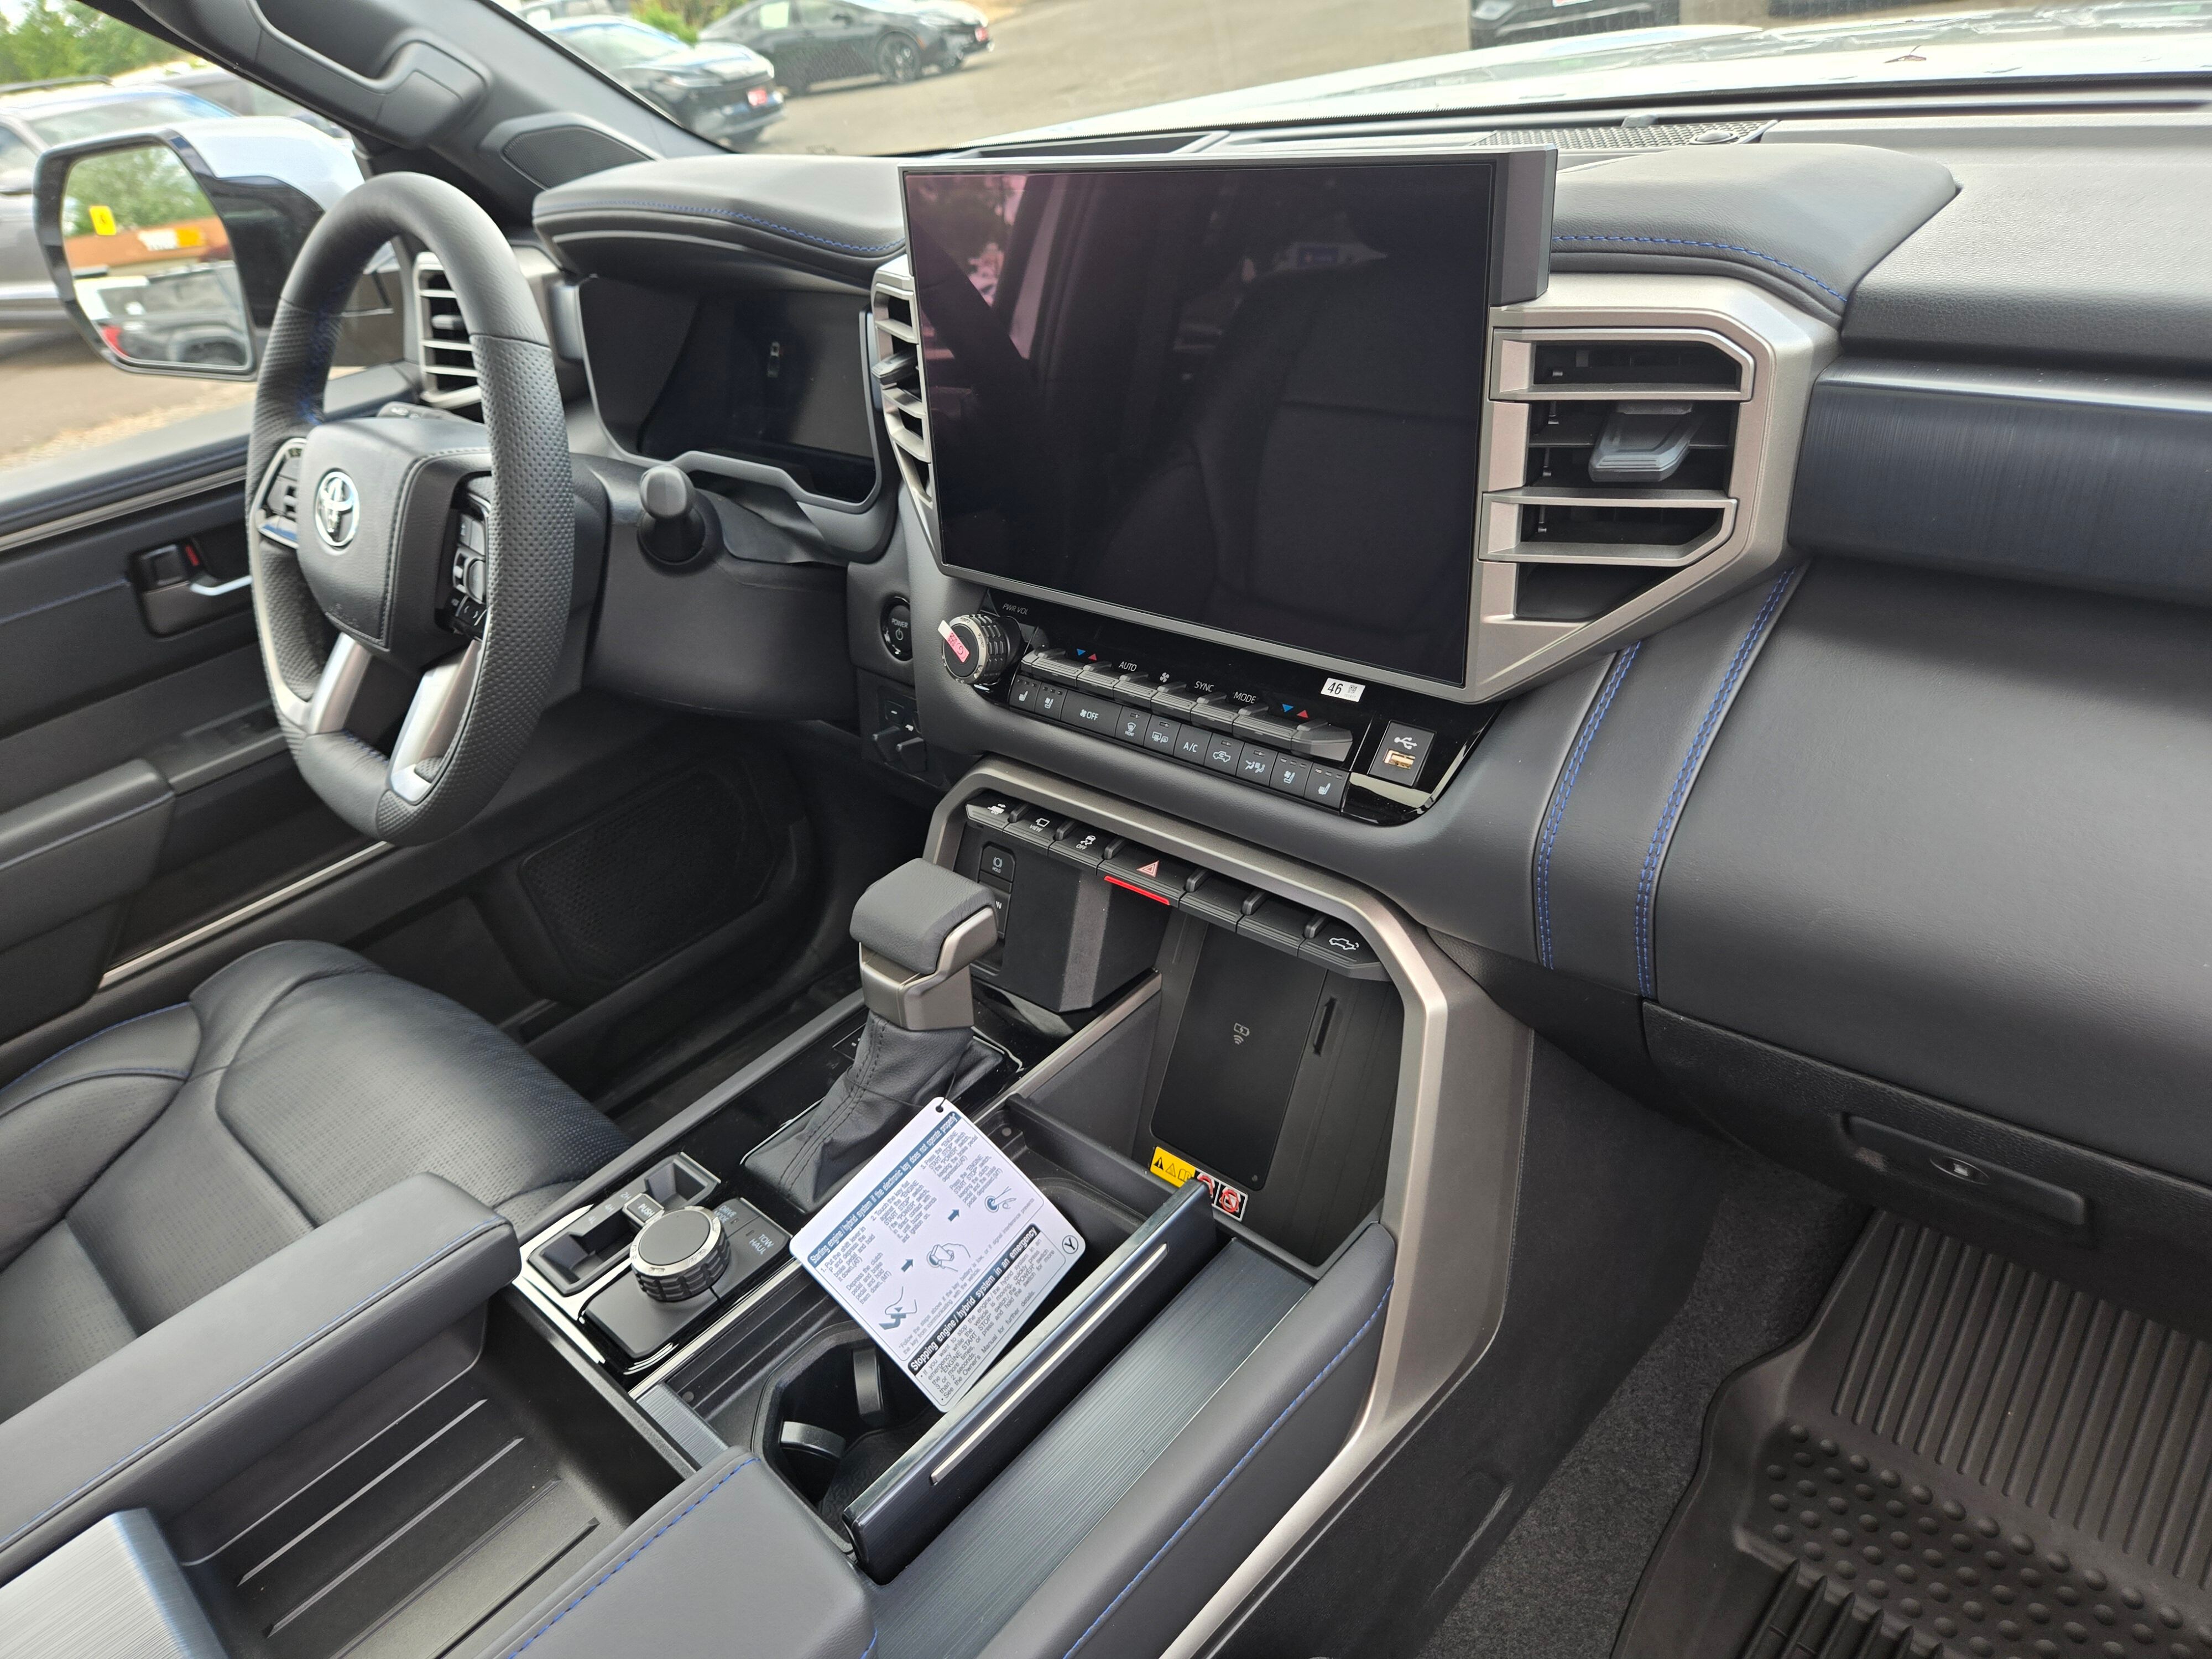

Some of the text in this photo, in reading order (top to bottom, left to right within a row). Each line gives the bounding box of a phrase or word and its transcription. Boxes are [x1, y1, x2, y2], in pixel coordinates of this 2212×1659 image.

[1003, 603, 1030, 615] PWR VOL
[891, 618, 908, 628] POWER
[1118, 661, 1137, 672] AUTO
[1194, 681, 1214, 692] SYNC
[1328, 682, 1343, 695] 46
[1233, 691, 1257, 704] MODE
[1086, 711, 1099, 721] OFF
[1183, 742, 1198, 753] A/C
[1029, 824, 1043, 832] VIEW
[620, 1191, 632, 1201] 2H
[605, 1203, 615, 1213] 4H
[638, 1203, 655, 1217] PUSH
[719, 1205, 737, 1217] DRIVE
[873, 1201, 889, 1217] Touch
[714, 1211, 729, 1223] MODE
[749, 1238, 766, 1255] HAUL
[759, 1234, 774, 1248] TOW
[823, 1258, 834, 1269] Put
[831, 1250, 842, 1260] the
[839, 1240, 851, 1253] shift
[849, 1230, 862, 1243] lever
[858, 1224, 867, 1233] in
[845, 1271, 865, 1291] Depress
[909, 1339, 940, 1373] Stopping
[973, 1273, 997, 1300] system
[993, 1265, 1003, 1276] in
[1000, 1258, 1010, 1269] an
[1008, 1226, 1039, 1260] emergency
[928, 1358, 939, 1370] you
[938, 1343, 951, 1358] want
[956, 1323, 969, 1337] stop
[967, 1313, 977, 1324] the
[999, 1270, 1015, 1287] hybrid
[1013, 1252, 1030, 1271] system
[1034, 1238, 1042, 1246] an
